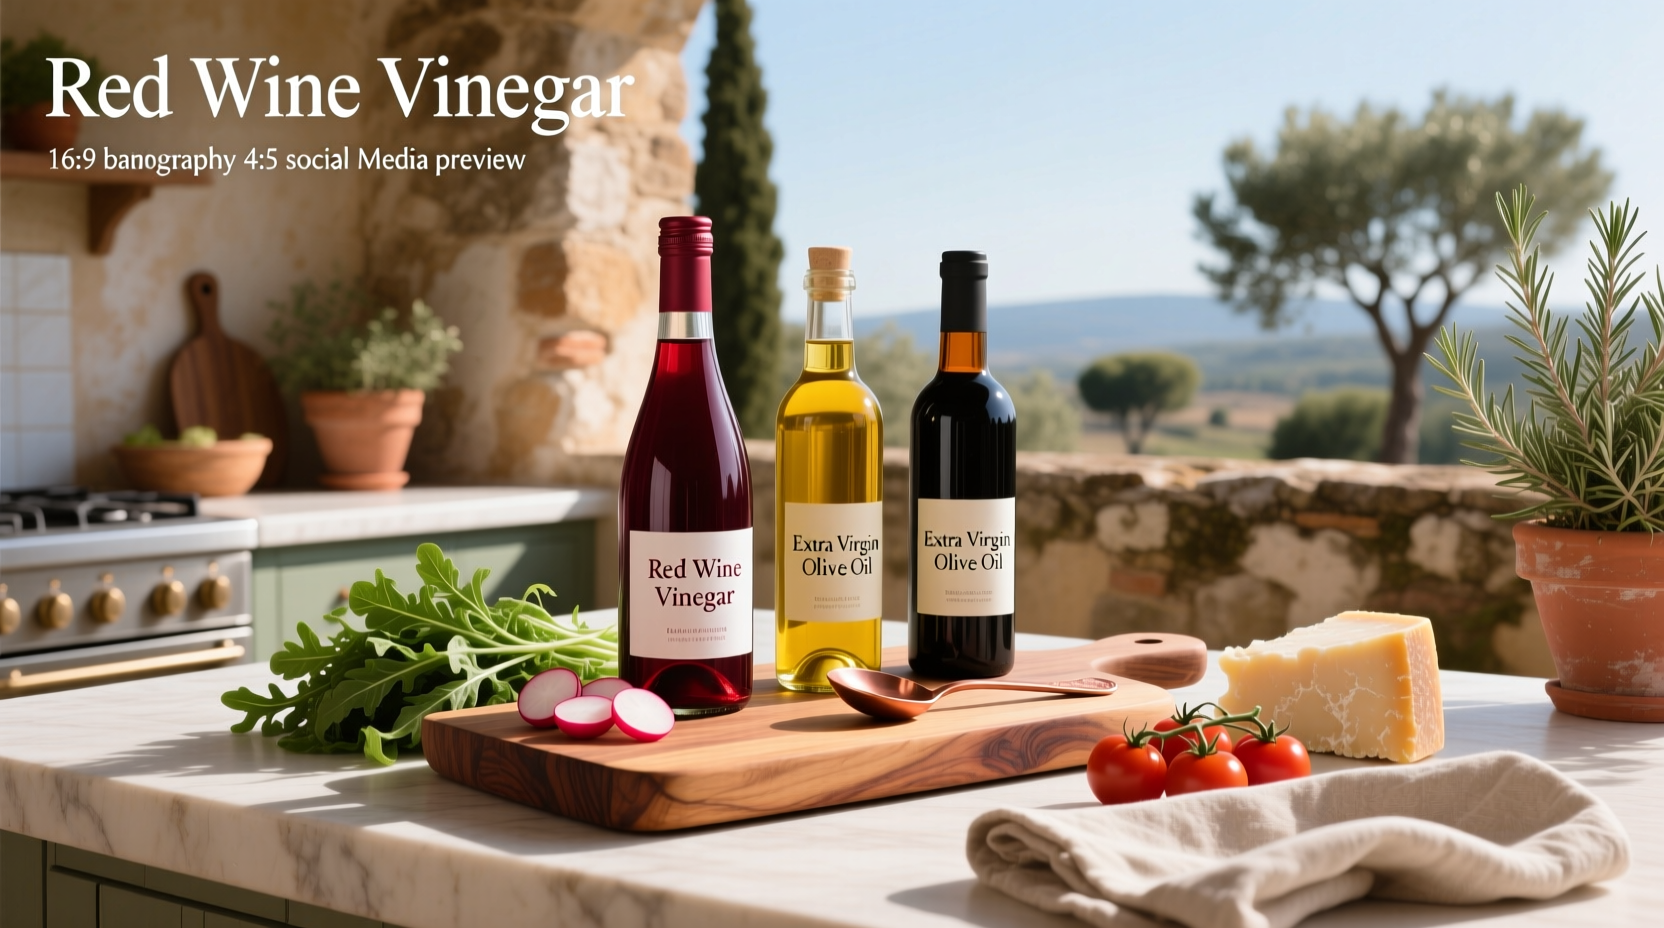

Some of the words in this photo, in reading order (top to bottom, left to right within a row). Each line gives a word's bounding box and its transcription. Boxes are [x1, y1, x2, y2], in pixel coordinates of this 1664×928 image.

[793, 534, 833, 552] Extra
[837, 535, 879, 556] Virgin
[924, 531, 962, 547] Extra
[967, 531, 1010, 551] Virgin
[648, 558, 687, 579] Red
[693, 558, 742, 579] Wine
[802, 557, 847, 576] Olive
[851, 556, 872, 575] Oil
[934, 553, 977, 571] Olive
[981, 553, 1003, 570] Oil
[655, 587, 735, 613] Vinegar
